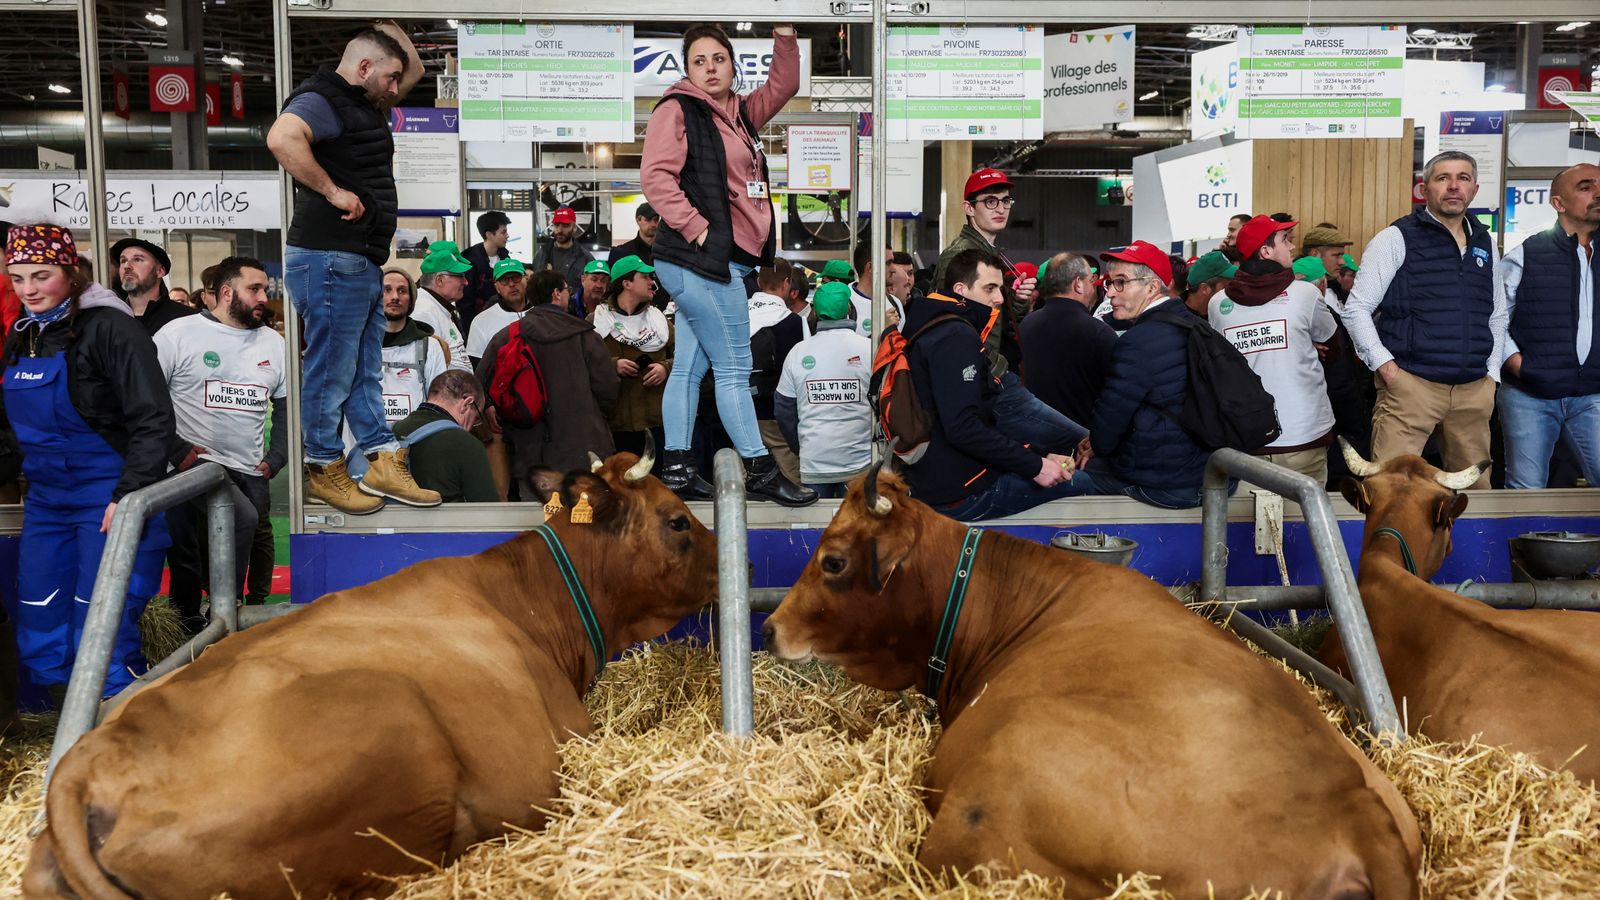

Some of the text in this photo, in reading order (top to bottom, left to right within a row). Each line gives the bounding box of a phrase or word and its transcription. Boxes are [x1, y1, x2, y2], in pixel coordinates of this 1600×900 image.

[534, 40, 563, 49] ORTIE
[943, 39, 980, 49] PIVOINE
[1304, 39, 1344, 48] PARESSE
[488, 49, 529, 57] TARENTAISE
[901, 49, 942, 57] TARENTAISE
[1341, 48, 1388, 56] FR7302286510
[1051, 60, 1117, 81] Village des
[52, 182, 250, 213] Raes Locales
[1198, 193, 1239, 209] BCTI
[69, 216, 235, 226] NOELLE AQUITAINE
[1236, 326, 1272, 340] FIERS DE
[1233, 336, 1285, 350] OUS NOURRIR
[221, 386, 258, 398] FIERS DE
[809, 382, 858, 392] SUR LA TÊTE
[208, 394, 233, 404] VOUS
[812, 392, 856, 401] ON MARCHE
[388, 399, 399, 407] DE
